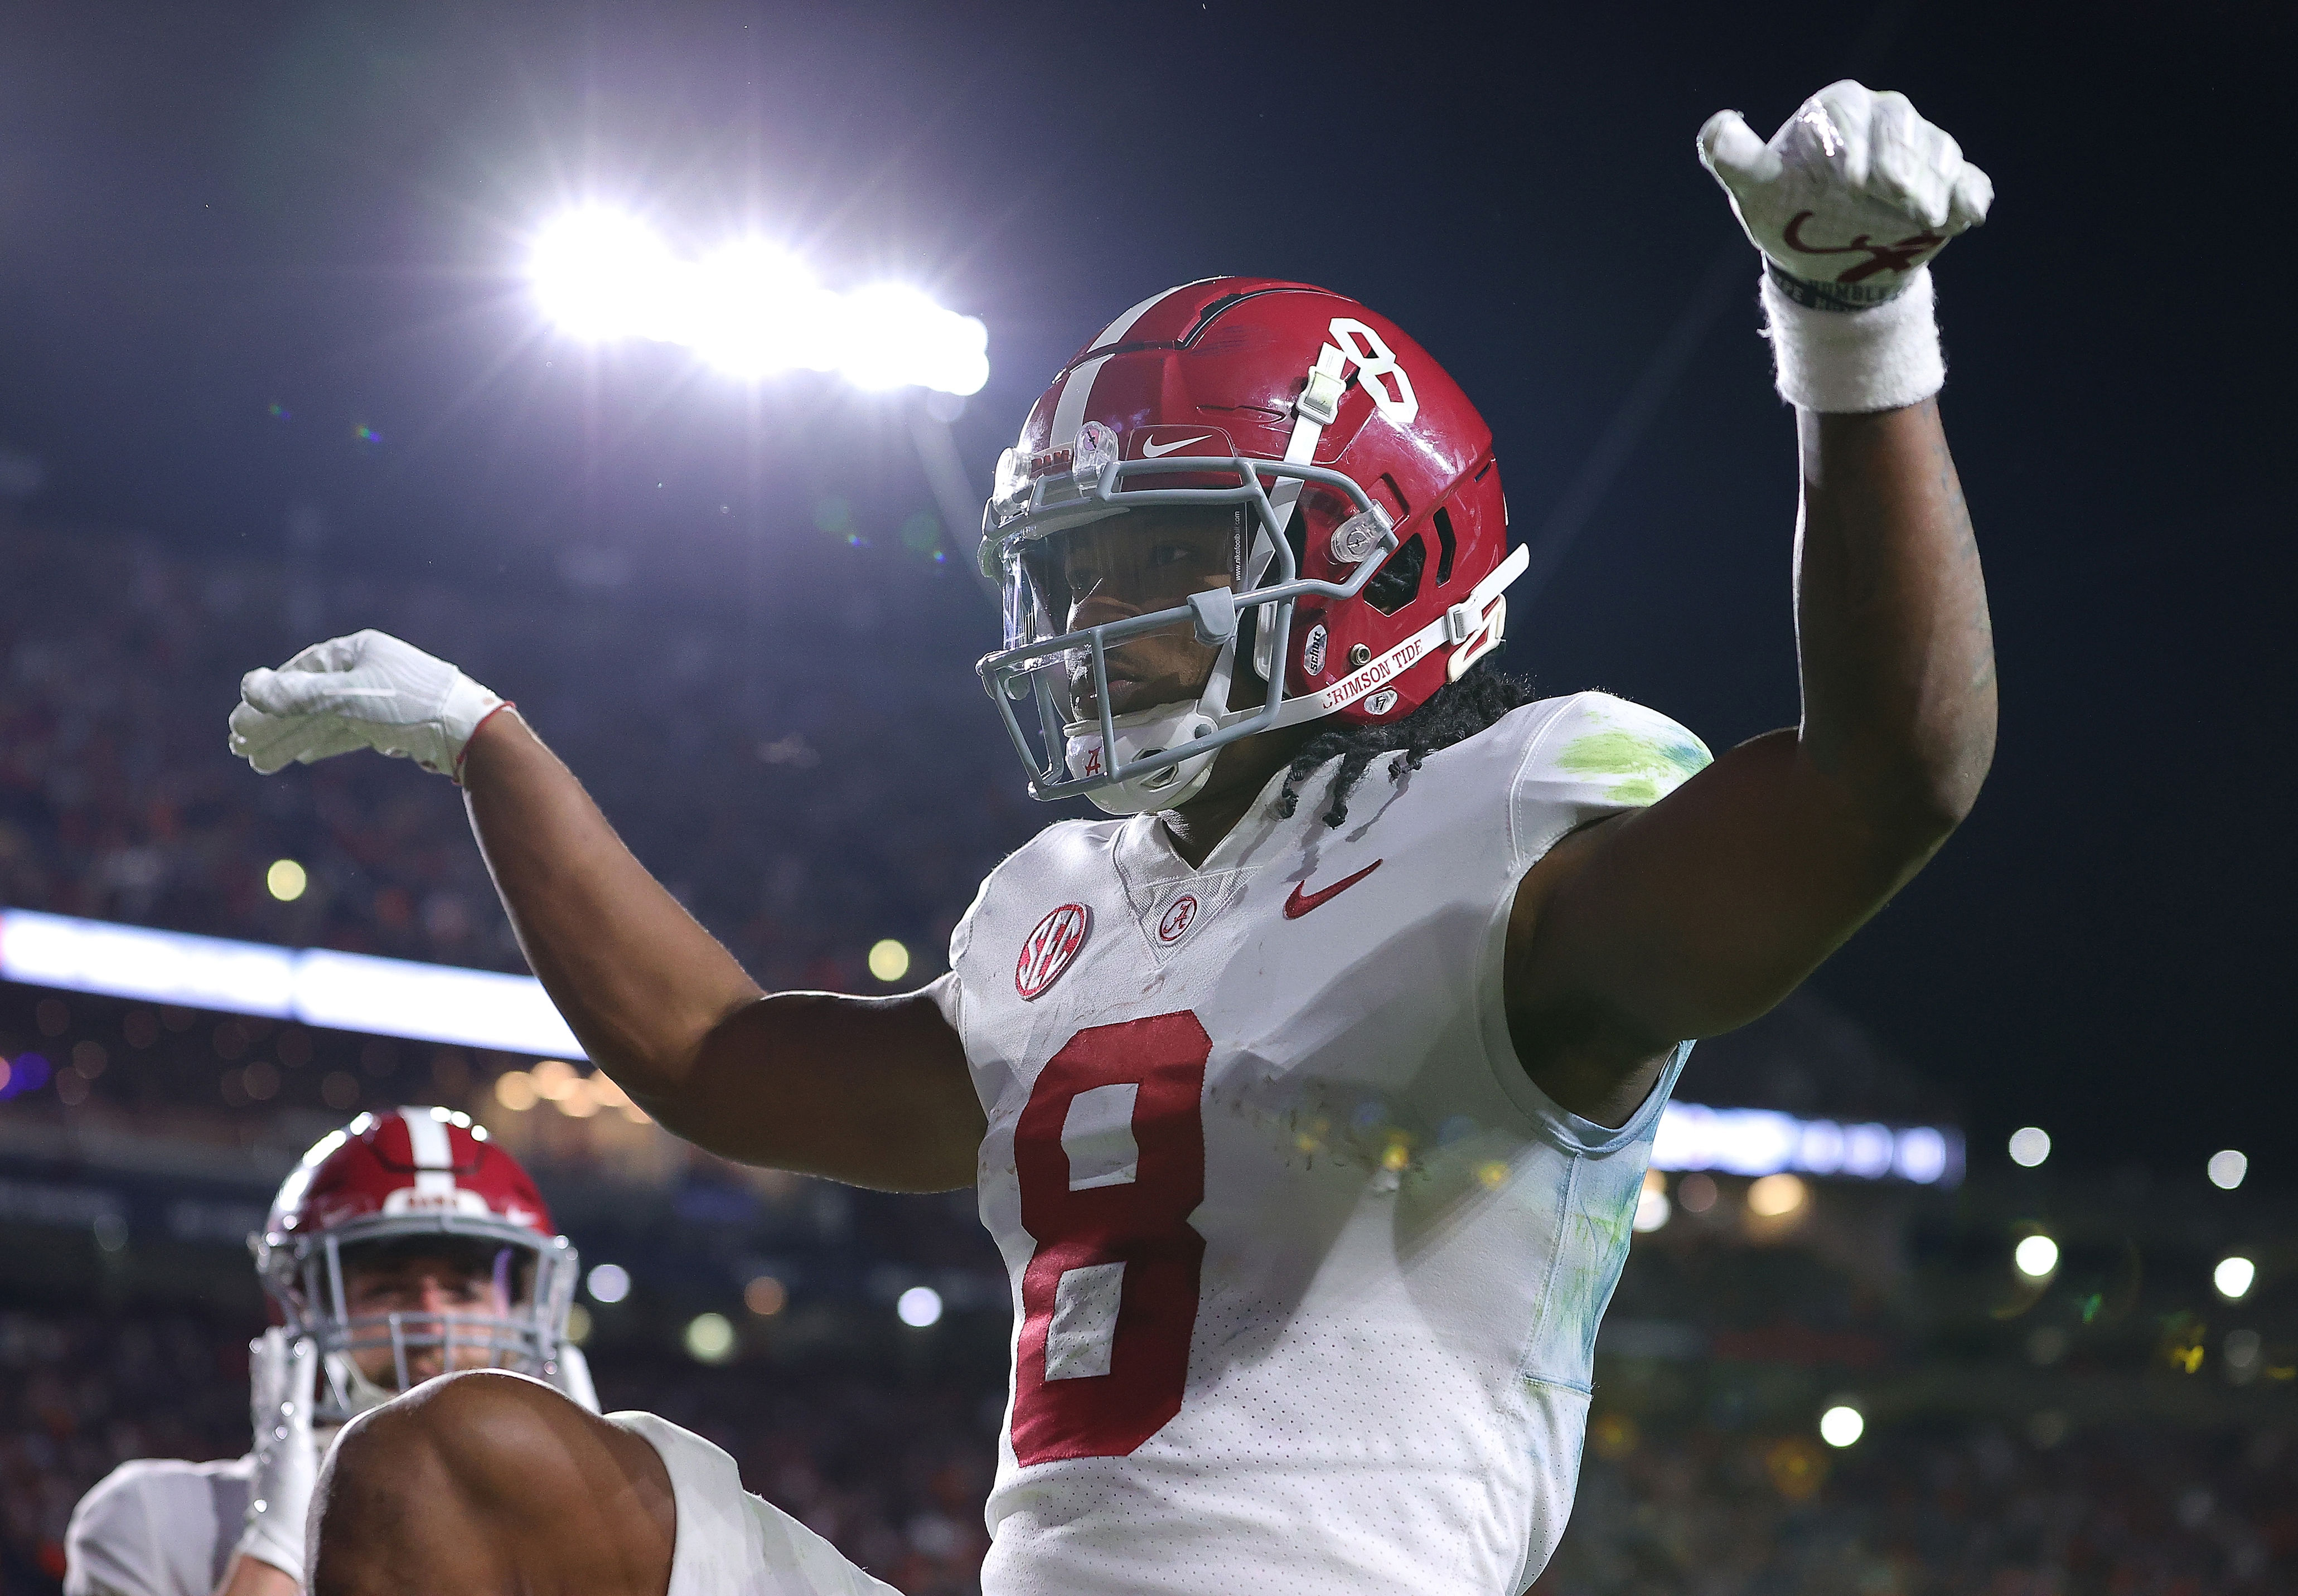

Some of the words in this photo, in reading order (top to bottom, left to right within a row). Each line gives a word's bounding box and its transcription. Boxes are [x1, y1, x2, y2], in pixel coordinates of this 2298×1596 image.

[1329, 318, 1419, 423] 8
[1322, 659, 1391, 709] CRIMSON
[1393, 639, 1423, 668] TIDE
[1375, 693, 1387, 712] F7
[1085, 746, 1101, 777] A
[1019, 908, 1081, 990] SEC
[1163, 902, 1192, 934] A
[1010, 1010, 1213, 1467] 8
